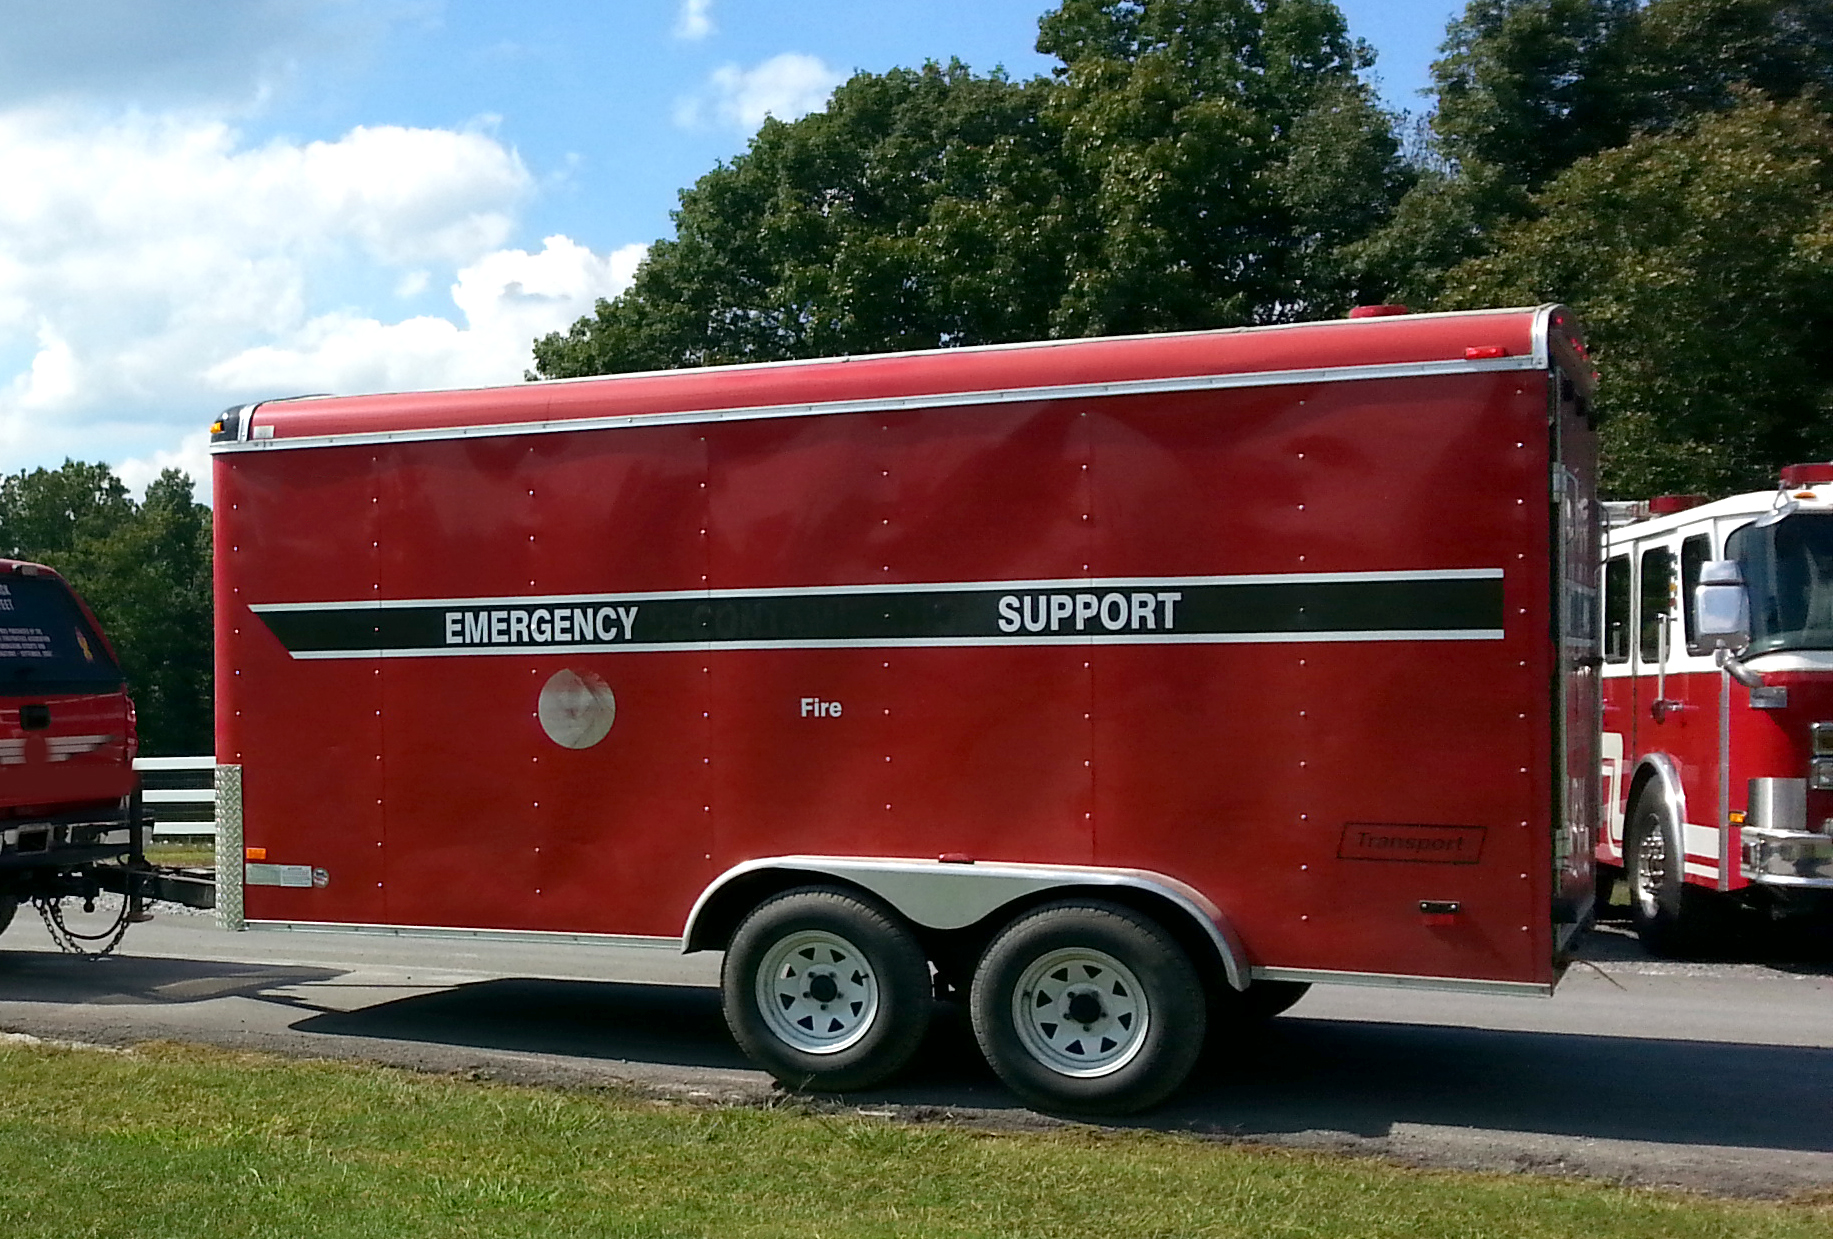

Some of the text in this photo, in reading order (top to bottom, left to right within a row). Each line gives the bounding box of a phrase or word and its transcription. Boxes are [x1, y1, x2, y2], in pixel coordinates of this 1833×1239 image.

[444, 606, 638, 645] EMERGENCY
[997, 592, 1182, 633] SUPPORT
[800, 698, 842, 718] Fire
[1357, 831, 1464, 853] Transport
